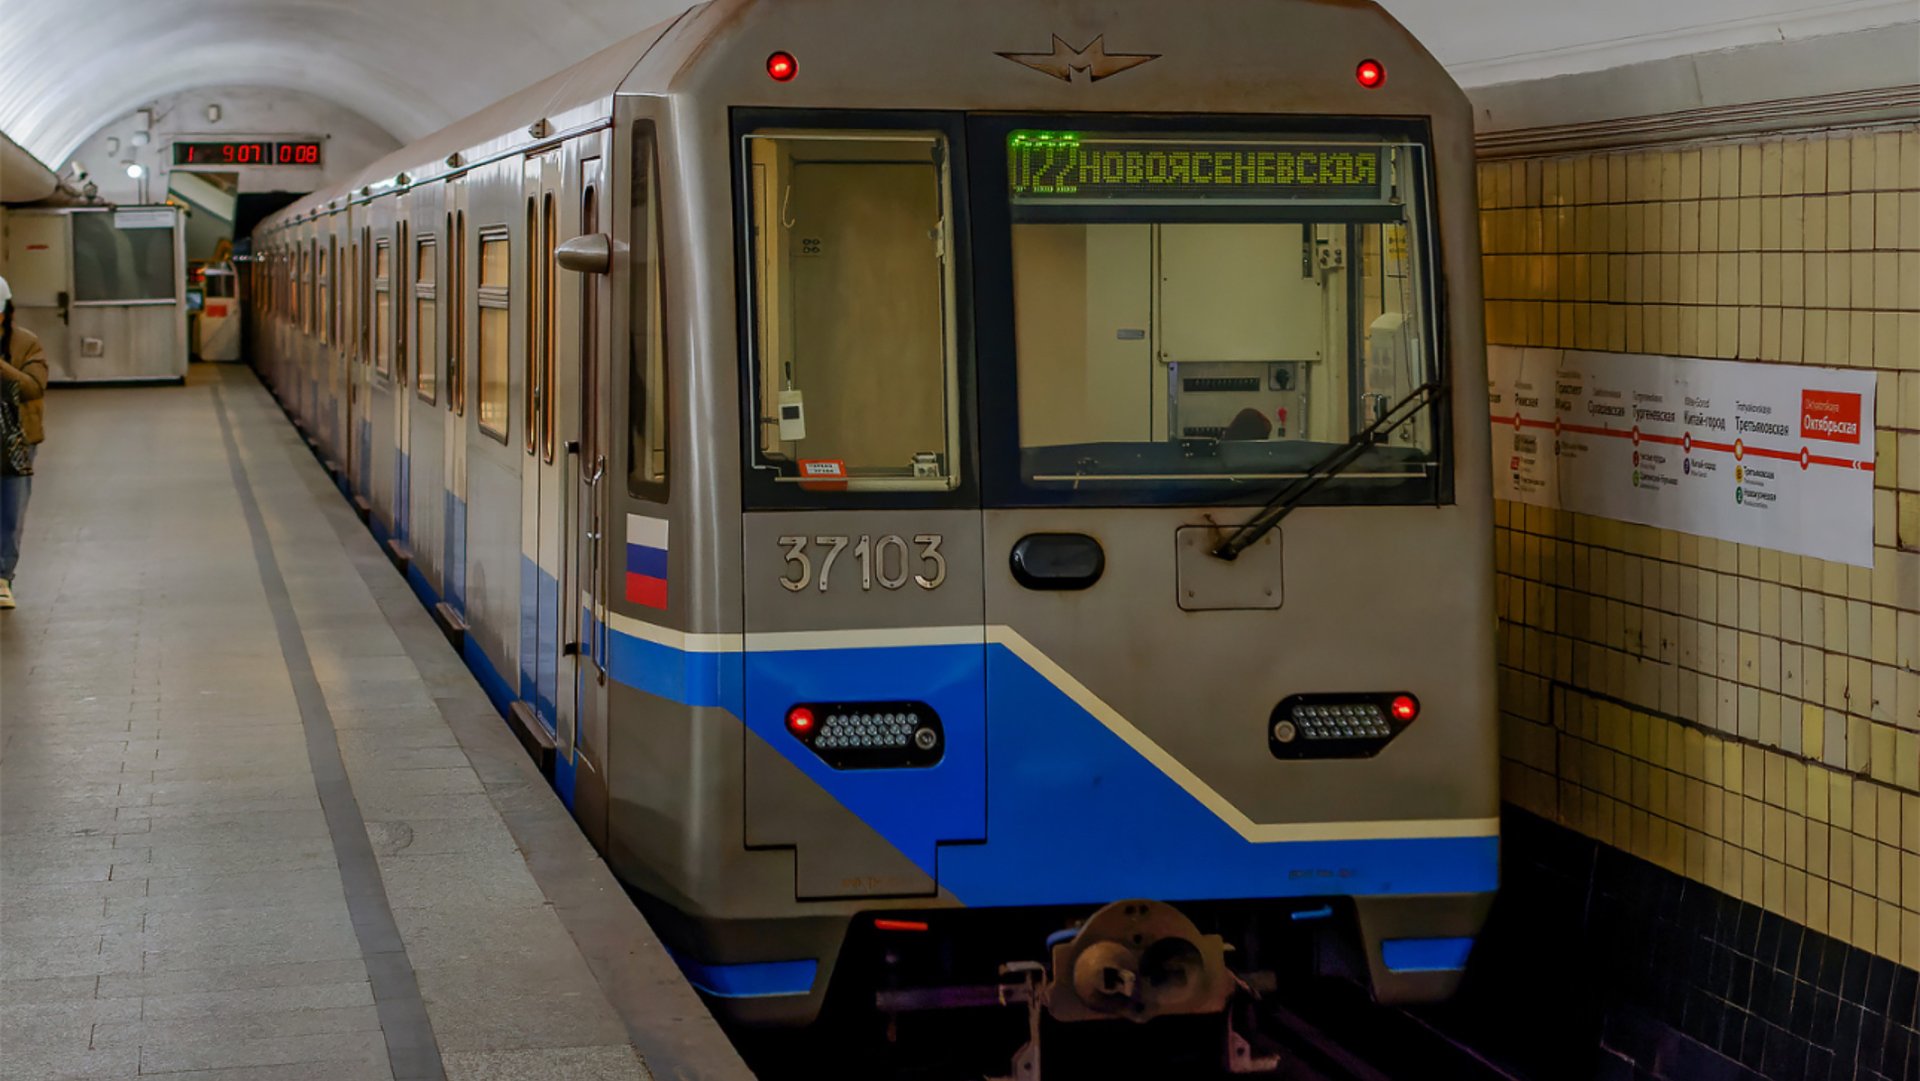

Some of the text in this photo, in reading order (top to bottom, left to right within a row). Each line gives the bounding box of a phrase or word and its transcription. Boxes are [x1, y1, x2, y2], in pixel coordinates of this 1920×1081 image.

[1079, 151, 1377, 184] НОВОЯСЕНЕВСКАЯ
[1803, 414, 1858, 437] Октябрьская
[778, 534, 947, 592] 37103
